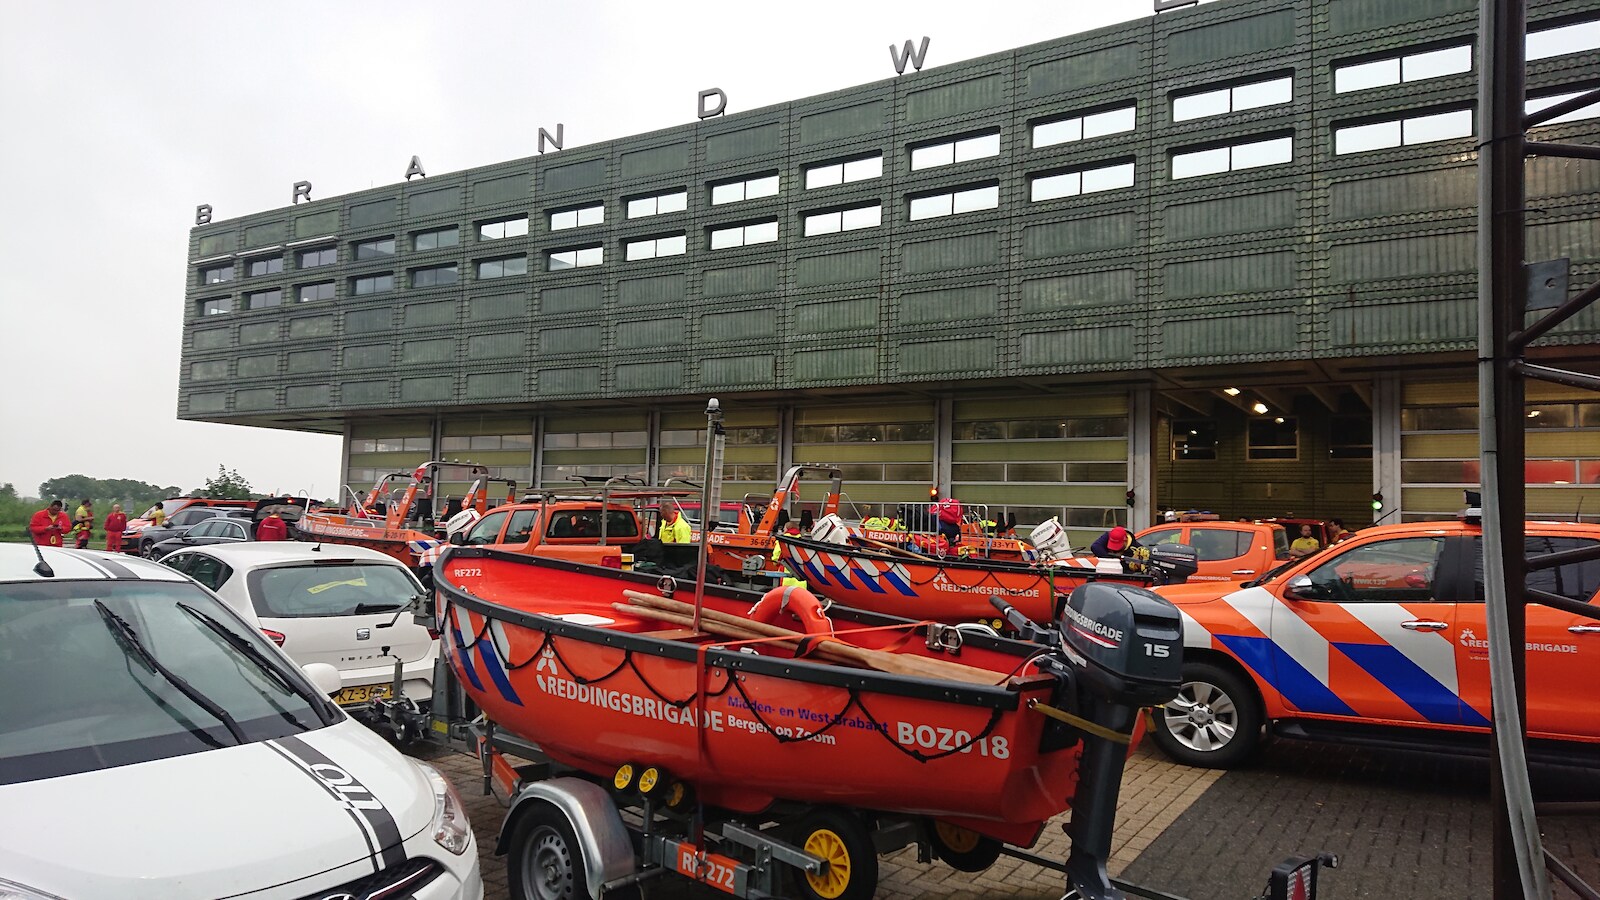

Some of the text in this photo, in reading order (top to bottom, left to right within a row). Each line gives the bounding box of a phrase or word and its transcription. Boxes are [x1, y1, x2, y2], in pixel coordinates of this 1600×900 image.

[454, 568, 482, 578] RF272
[1143, 643, 1170, 658] 15
[547, 675, 725, 732] REDDINGSBRIGADE
[727, 695, 889, 734] Midden- en West-Brabant
[896, 721, 1011, 760] BOZ018
